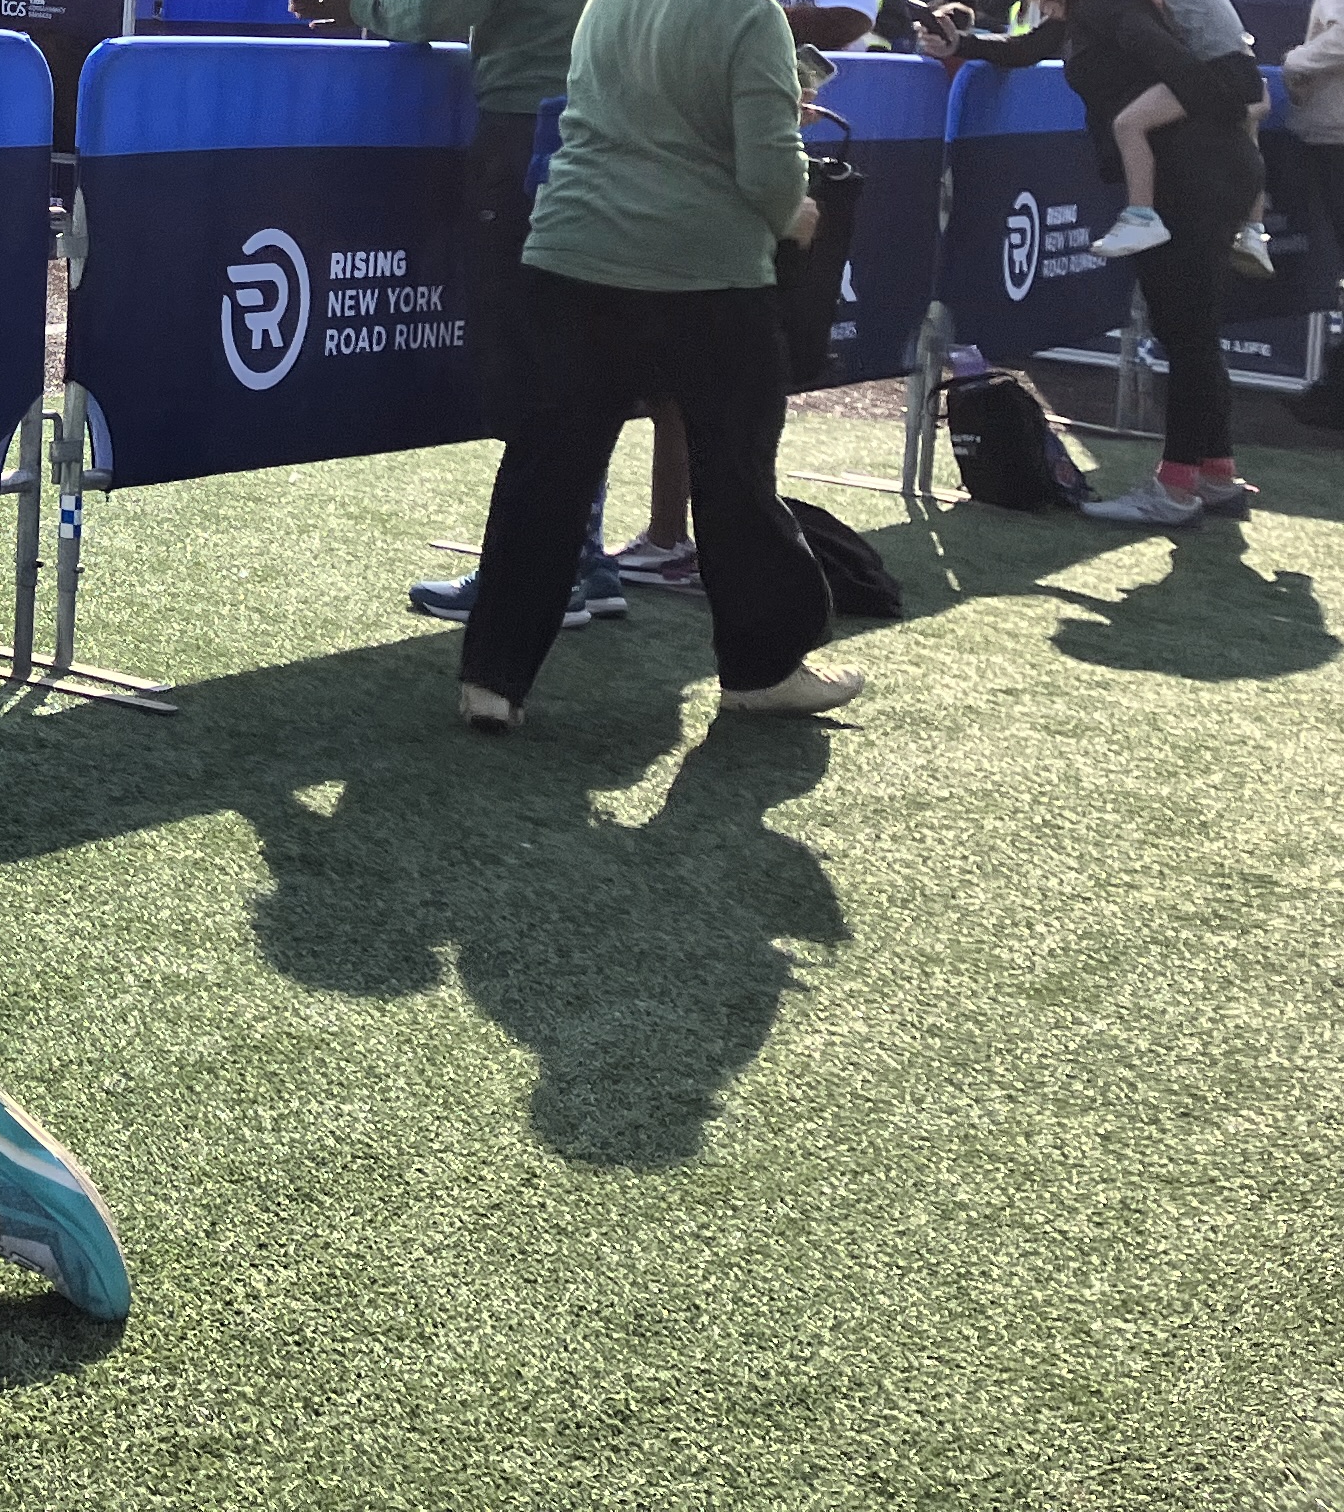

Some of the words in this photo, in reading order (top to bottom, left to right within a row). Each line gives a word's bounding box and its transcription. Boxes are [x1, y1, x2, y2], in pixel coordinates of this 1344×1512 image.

[330, 250, 407, 279] RISING
[328, 288, 379, 318] NEW
[387, 285, 444, 314] YORK
[325, 325, 387, 356] ROAD
[394, 320, 466, 350] RUNNE
